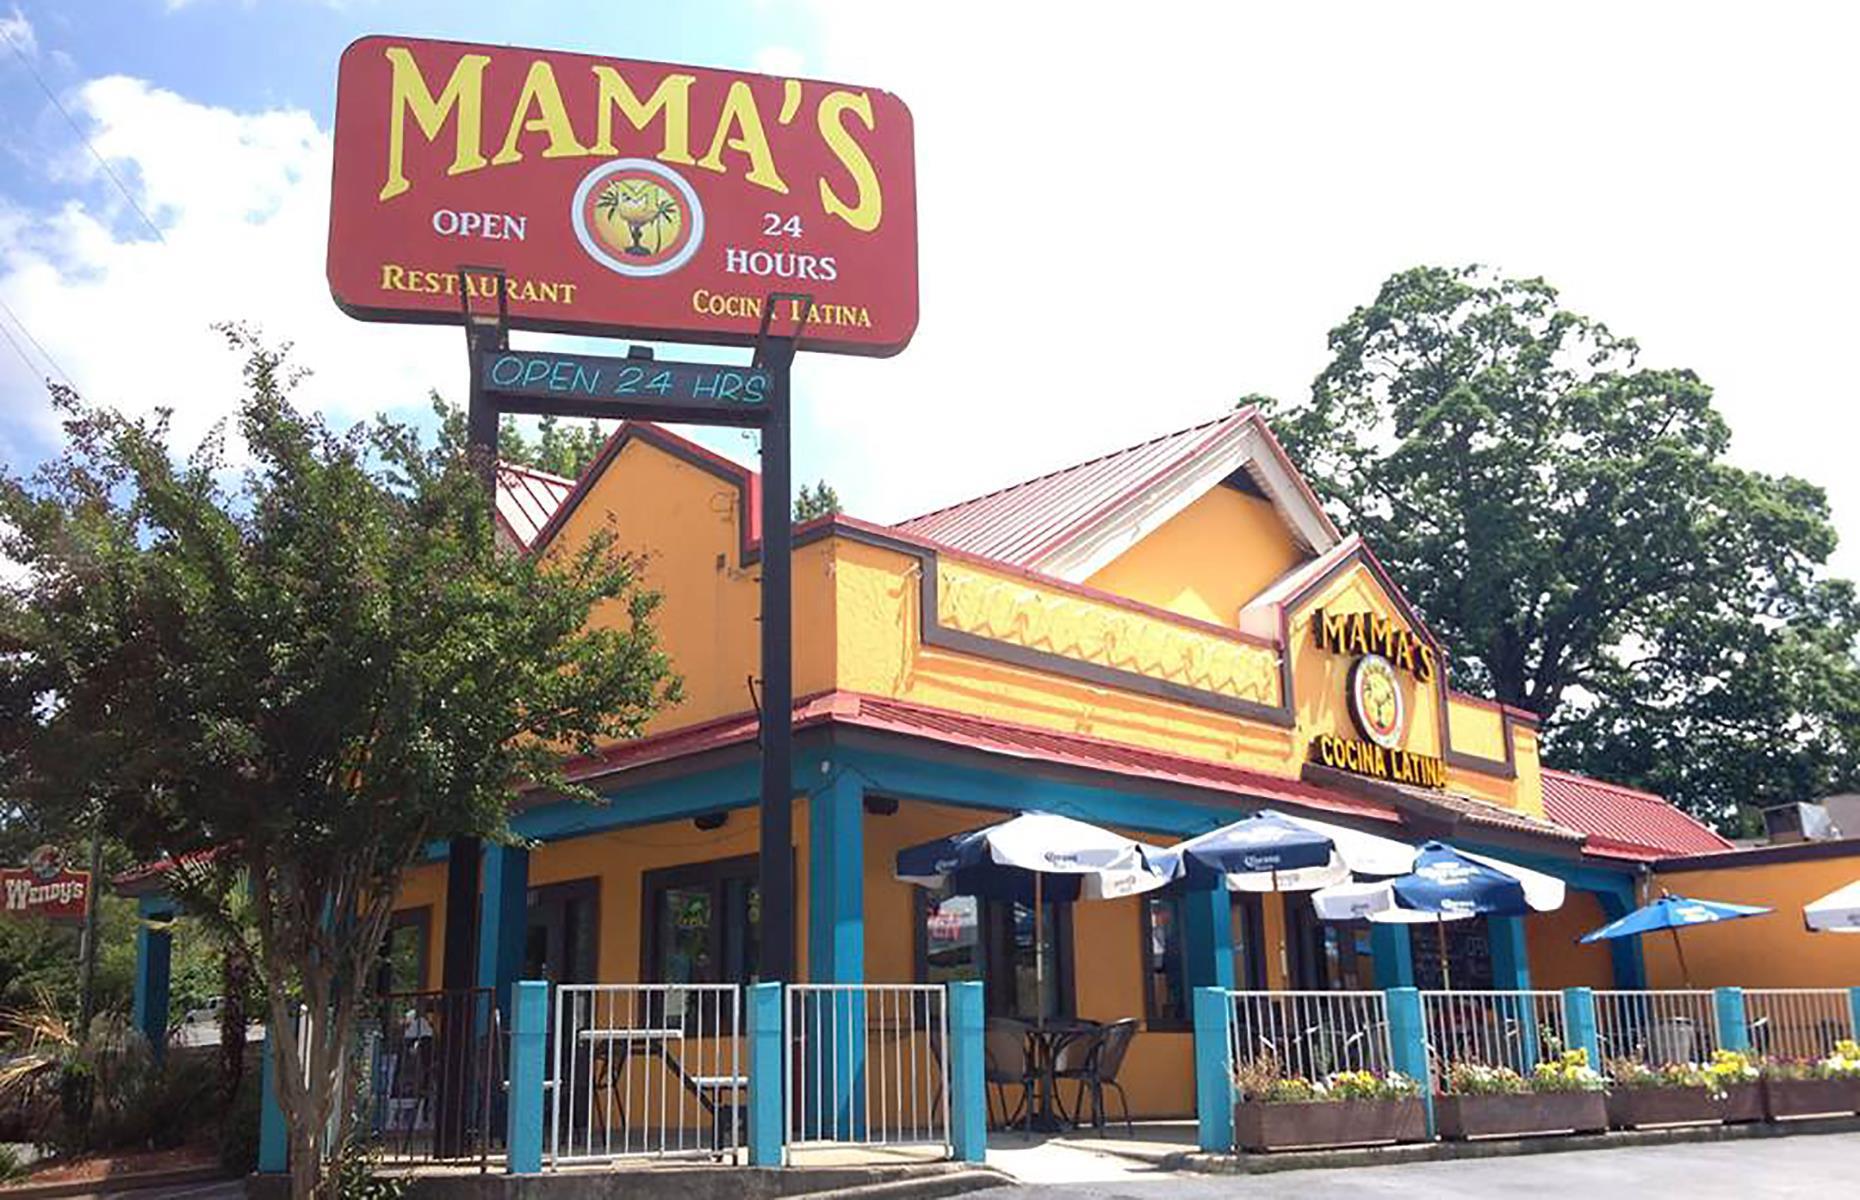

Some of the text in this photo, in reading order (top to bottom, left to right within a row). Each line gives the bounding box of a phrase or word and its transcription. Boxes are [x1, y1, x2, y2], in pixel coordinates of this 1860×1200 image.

[379, 46, 883, 232] MAMA'S
[432, 209, 528, 240] OPEN
[763, 212, 803, 238] 24
[725, 248, 838, 281] HOURS
[381, 264, 577, 305] RESTAURANT
[692, 289, 775, 320] COCIN
[491, 356, 768, 403] OPEN 24 HRS
[1315, 607, 1436, 683] MAMA'S
[1320, 733, 1388, 778] COCINA
[5, 878, 85, 911] Wendy's
